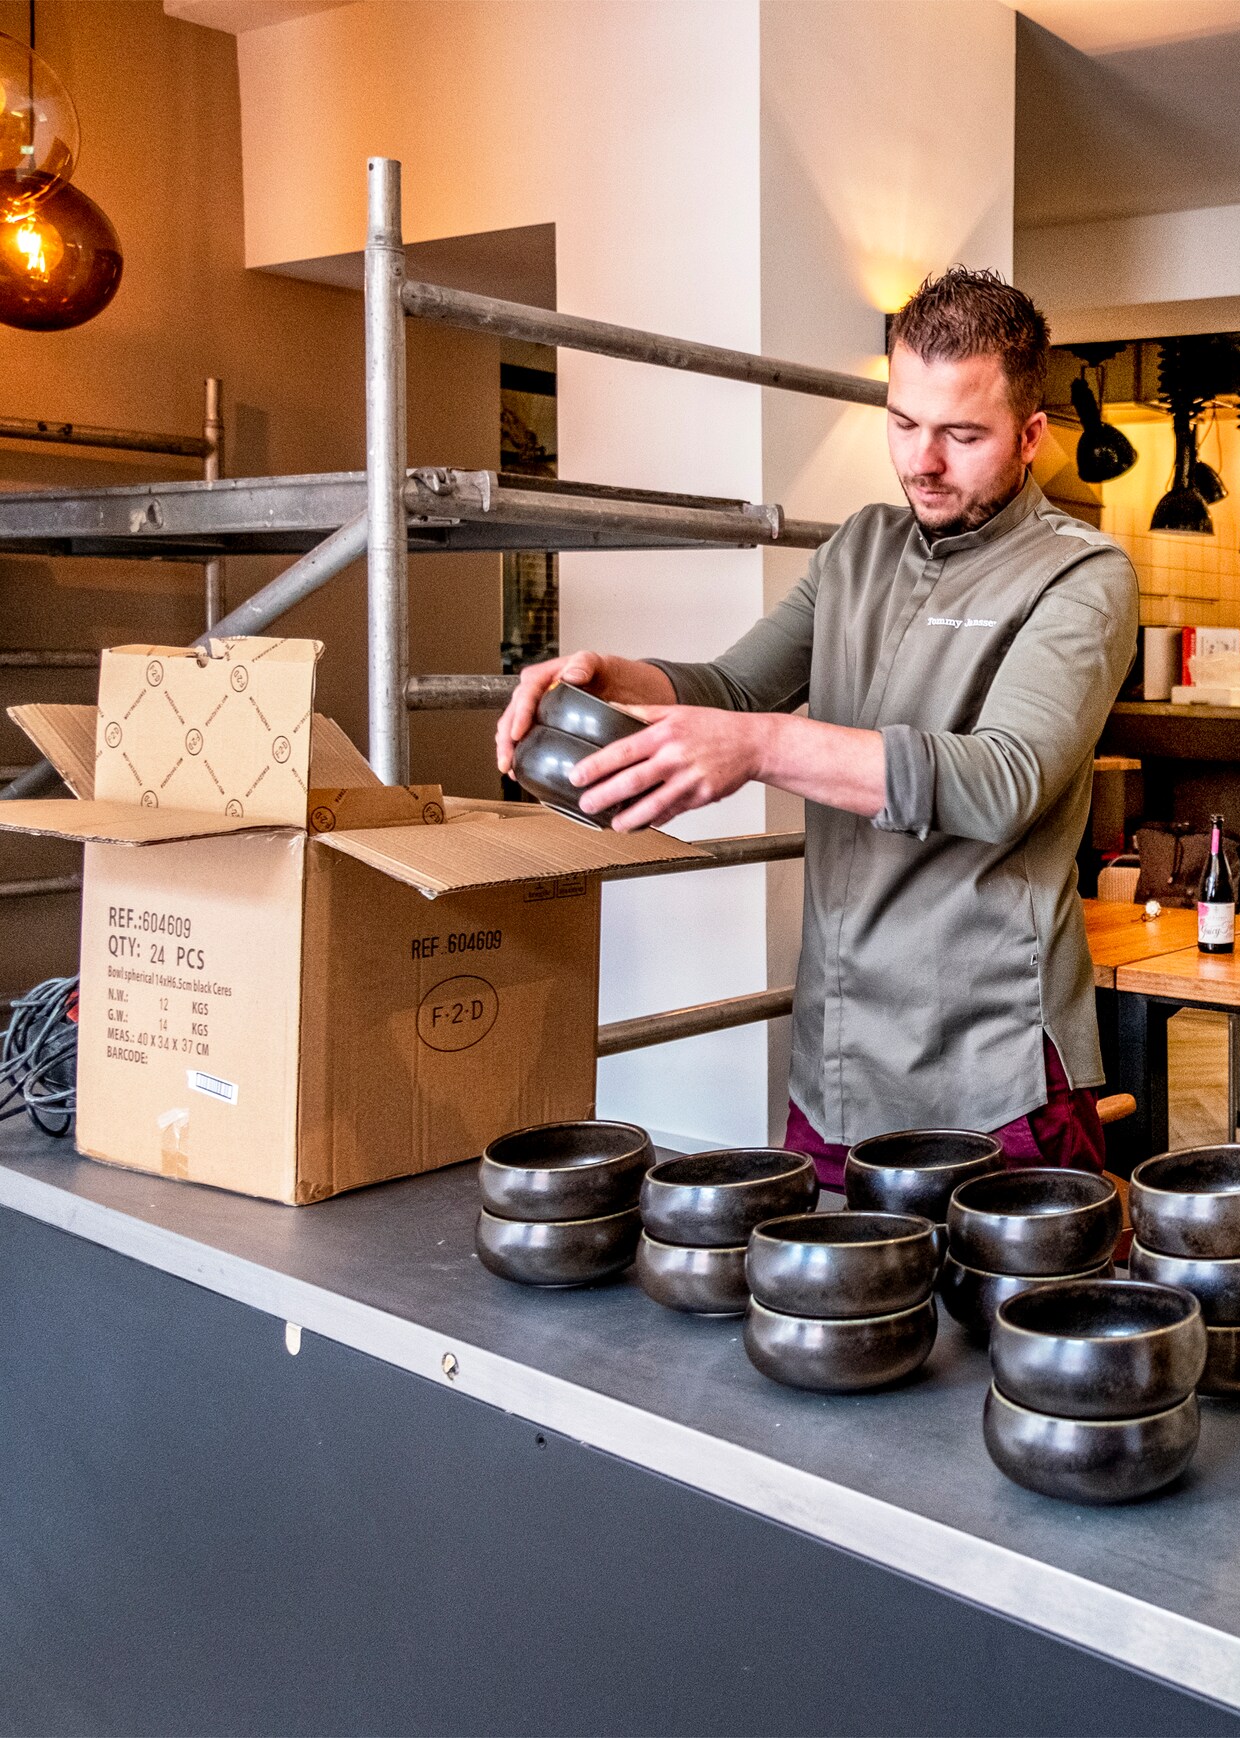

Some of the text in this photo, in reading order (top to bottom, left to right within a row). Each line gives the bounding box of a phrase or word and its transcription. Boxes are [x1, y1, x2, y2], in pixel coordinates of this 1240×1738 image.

[927, 617, 963, 629] Tommy
[108, 935, 205, 970] QTY: 24 PCS
[108, 965, 124, 980] Bowl
[193, 979, 212, 994] black
[213, 982, 232, 997] Ceres
[159, 998, 169, 1011] 12
[192, 1001, 209, 1016] KGS
[159, 1018, 168, 1031] 14
[191, 1022, 209, 1037] KGS
[137, 1032, 148, 1047] 40
[158, 1035, 170, 1050] 34
[181, 1038, 194, 1054] 37
[196, 1042, 210, 1056] CM
[107, 1046, 149, 1065] BARCODE:
